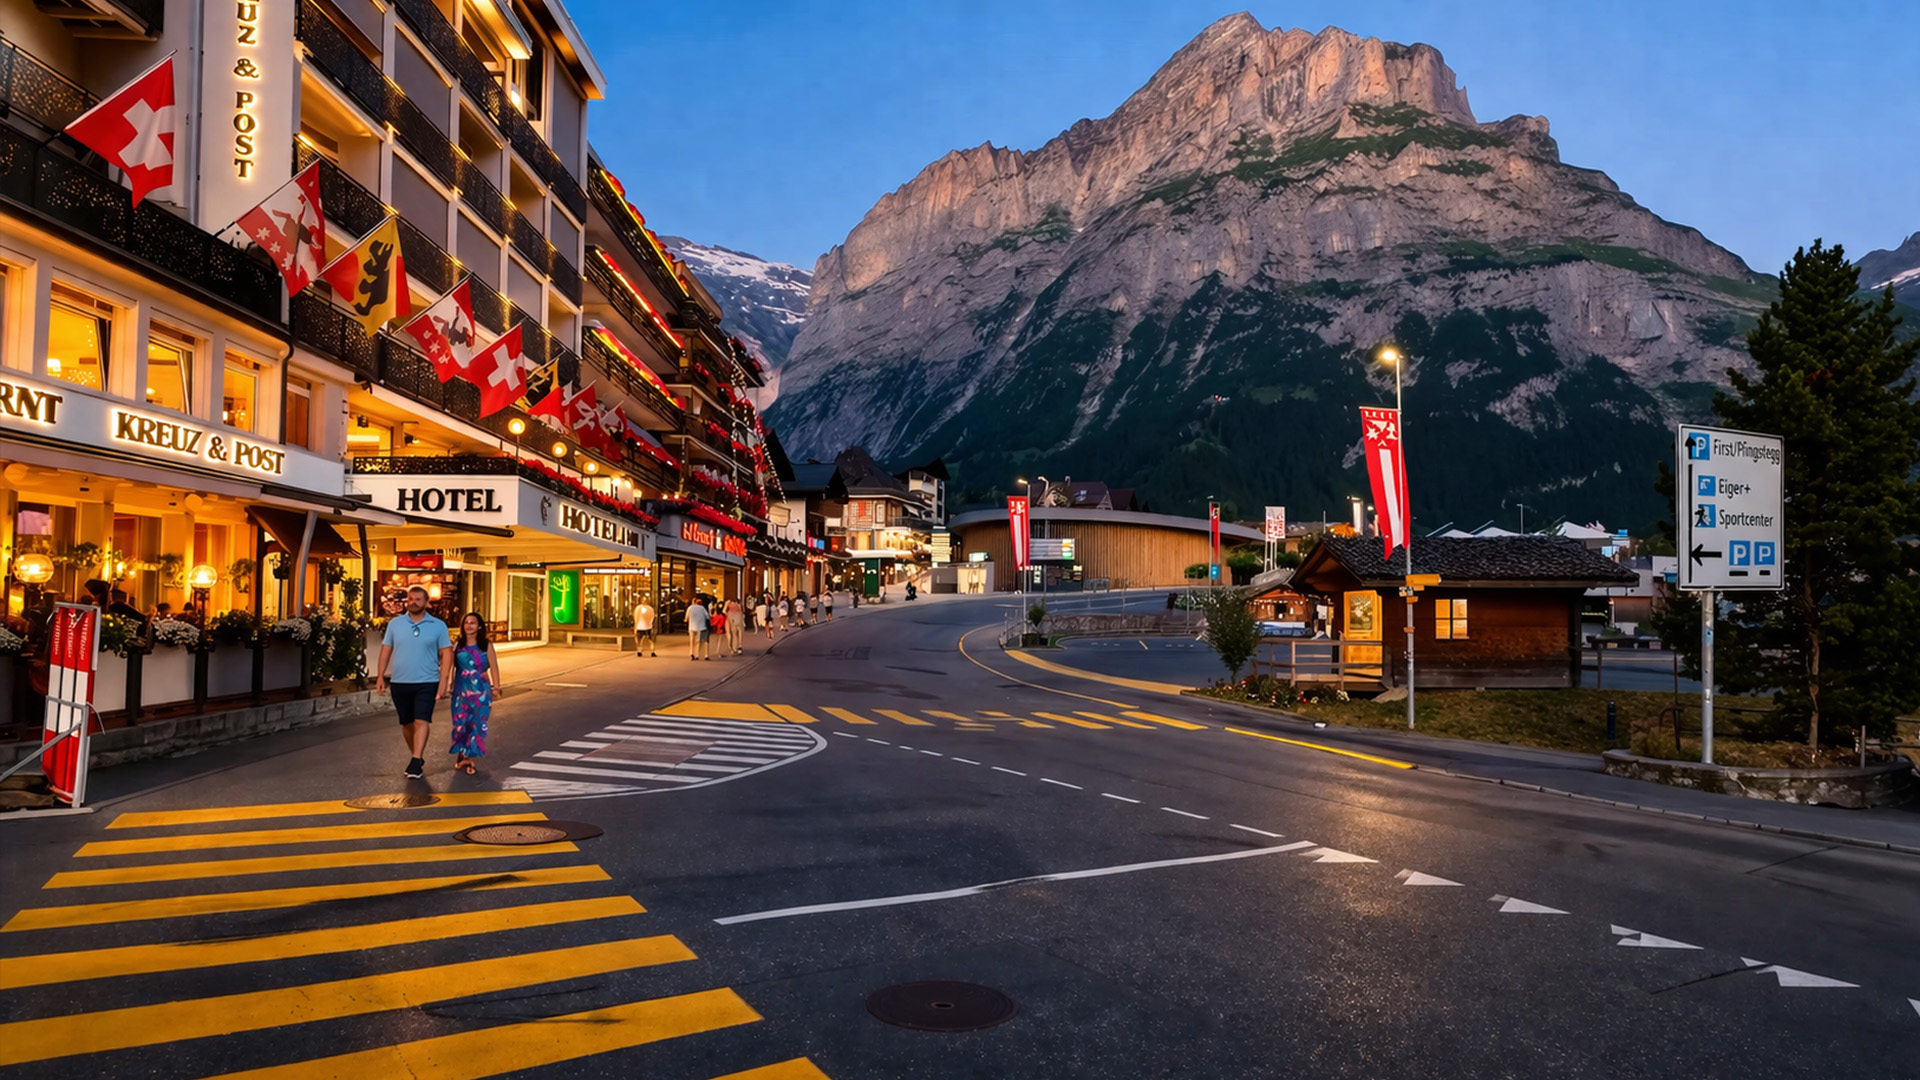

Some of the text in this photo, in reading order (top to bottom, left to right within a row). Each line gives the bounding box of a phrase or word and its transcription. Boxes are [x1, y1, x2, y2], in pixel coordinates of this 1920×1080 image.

[233, 0, 259, 178] UZ & POST
[115, 411, 285, 474] KREUZ & POST
[396, 488, 502, 512] HOTEL
[1718, 478, 1751, 498] Eiger+
[1719, 509, 1773, 529] Sportcenter
